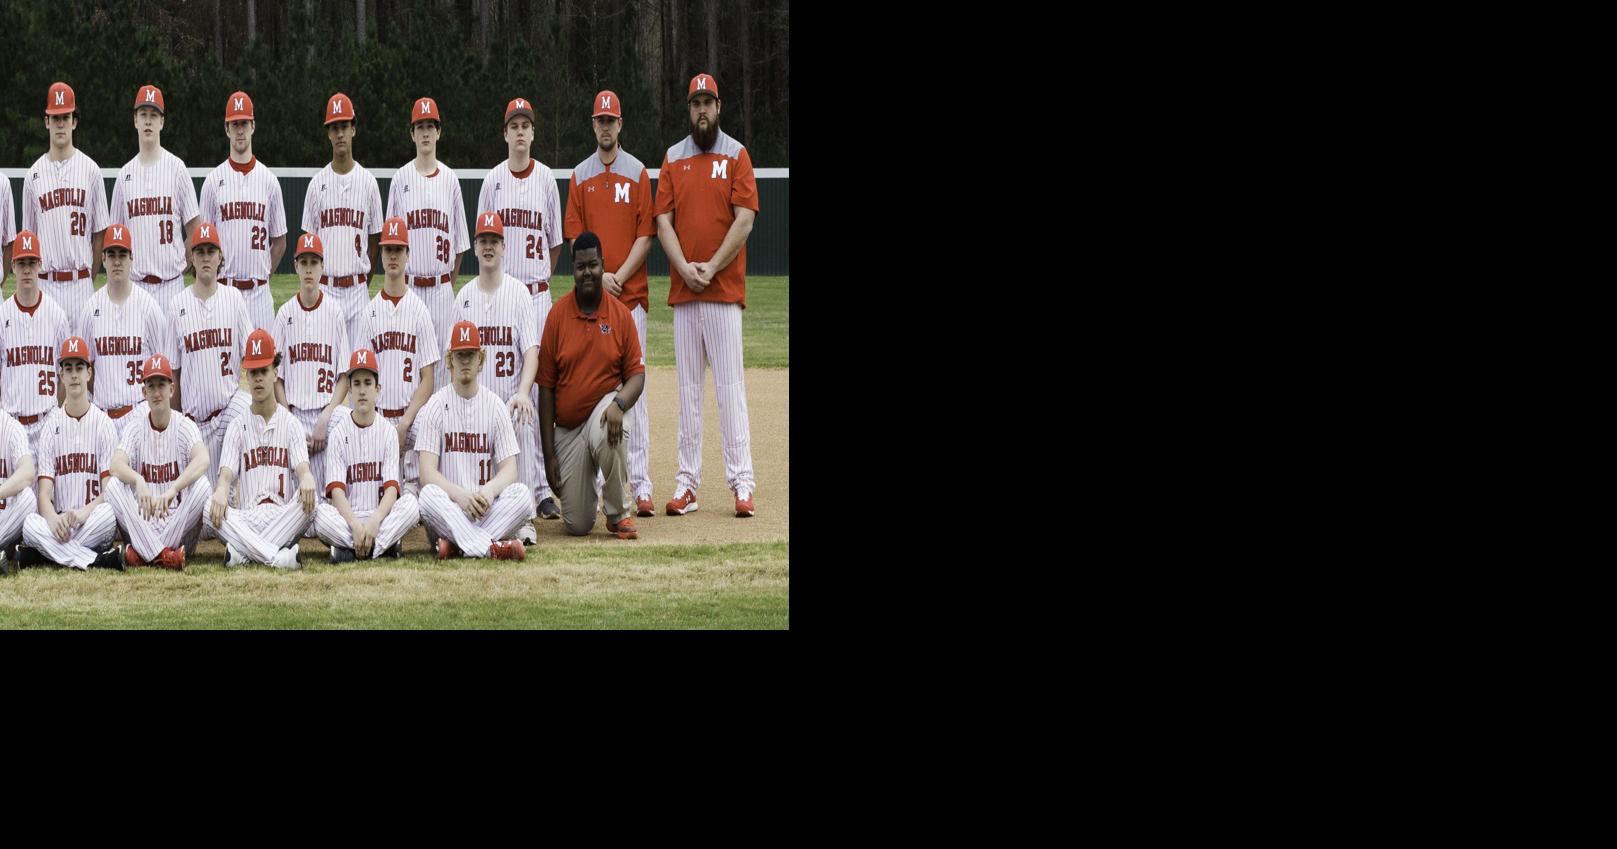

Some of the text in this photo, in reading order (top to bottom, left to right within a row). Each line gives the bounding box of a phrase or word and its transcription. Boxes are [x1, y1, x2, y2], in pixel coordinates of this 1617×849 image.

[697, 78, 706, 90] M
[55, 92, 64, 105] M
[146, 90, 155, 102] M
[234, 98, 243, 110] M
[516, 100, 525, 108] M
[602, 96, 610, 108] M
[333, 101, 342, 113] M
[421, 102, 430, 113] M
[712, 160, 727, 179] M
[39, 188, 85, 213] MAGNOLIA
[615, 183, 629, 203] M
[127, 196, 173, 217] MAGNOLIA
[220, 201, 265, 222] MAGNOLIA
[71, 213, 86, 236] 20
[320, 208, 365, 229] MAGNOLIA
[407, 210, 450, 233] MAGNOLIA
[485, 215, 494, 227] M
[113, 228, 122, 240] M
[159, 221, 173, 244] 18
[200, 226, 209, 238] M
[251, 226, 266, 250] 22
[389, 223, 398, 235] M
[22, 237, 32, 250] M
[304, 236, 313, 248] M
[436, 236, 450, 264] 28
[526, 234, 543, 259] 24
[460, 328, 470, 342] M
[69, 340, 78, 352] M
[95, 336, 142, 356] MAGNOLIA
[252, 340, 262, 355] M
[6, 346, 54, 367] MAGNOLIA
[152, 358, 161, 369] M
[221, 353, 234, 376] 2
[357, 351, 366, 364] M
[496, 352, 515, 378] 23
[127, 360, 143, 385] 35
[403, 358, 412, 382] 2
[38, 371, 55, 396] 25
[318, 368, 335, 393] 26
[479, 459, 492, 485] 11
[85, 479, 99, 505] 15
[278, 473, 285, 497] 1
